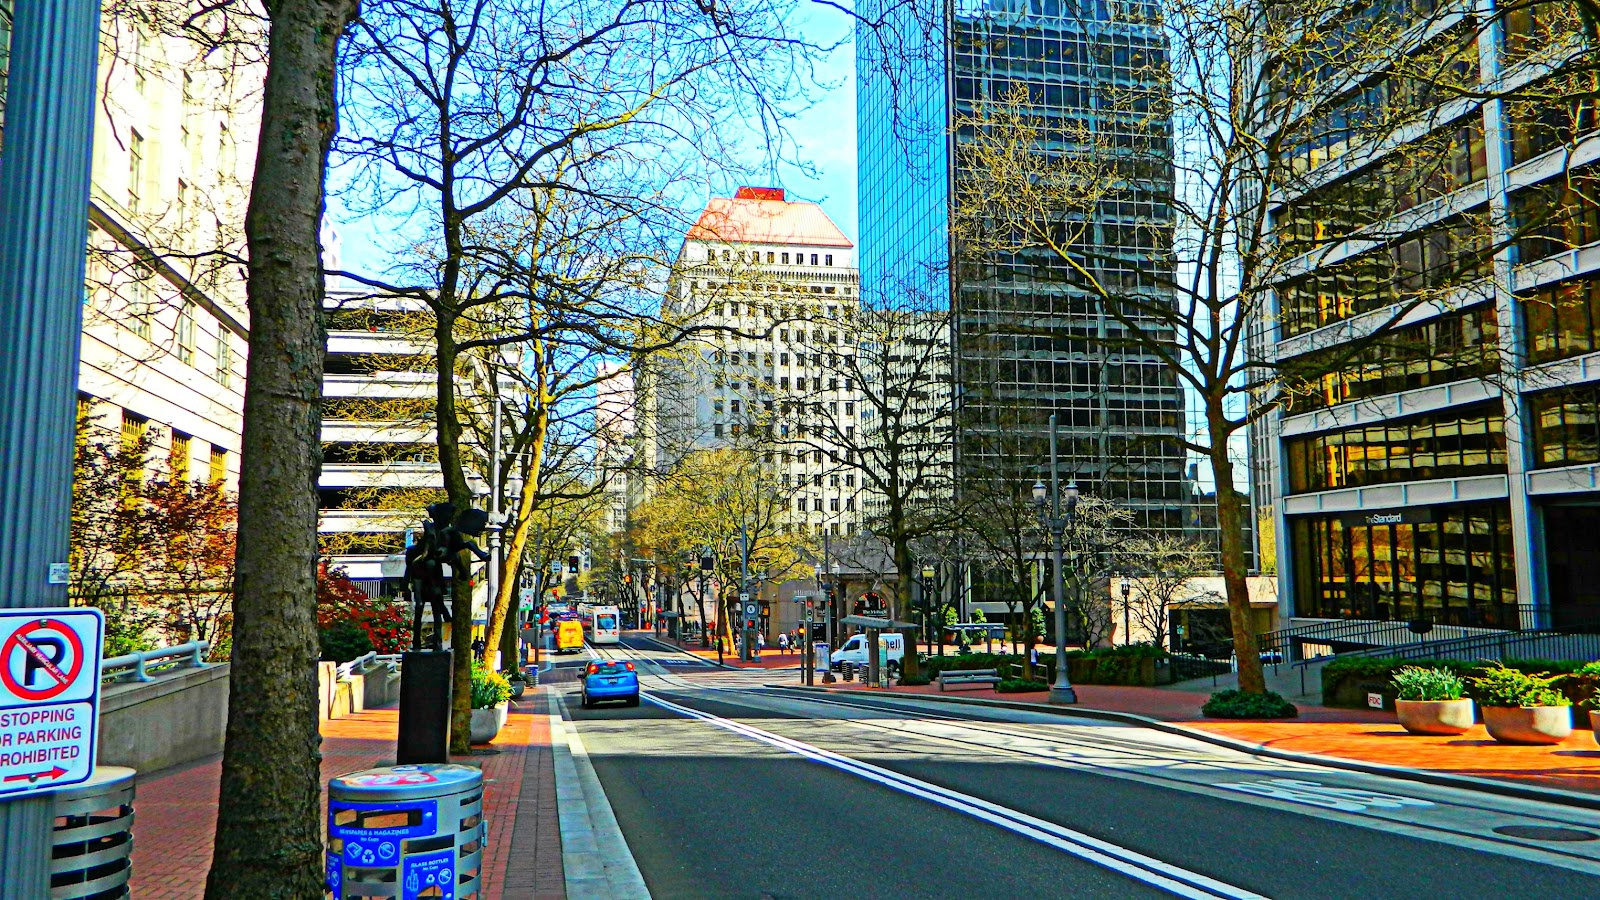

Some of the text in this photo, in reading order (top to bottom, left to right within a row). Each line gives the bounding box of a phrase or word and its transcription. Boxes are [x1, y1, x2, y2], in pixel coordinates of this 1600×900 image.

[1373, 513, 1402, 523] Standard
[0, 708, 75, 727] STOPPING
[0, 726, 82, 747] R PARKING
[0, 745, 80, 767] ROHIBITED
